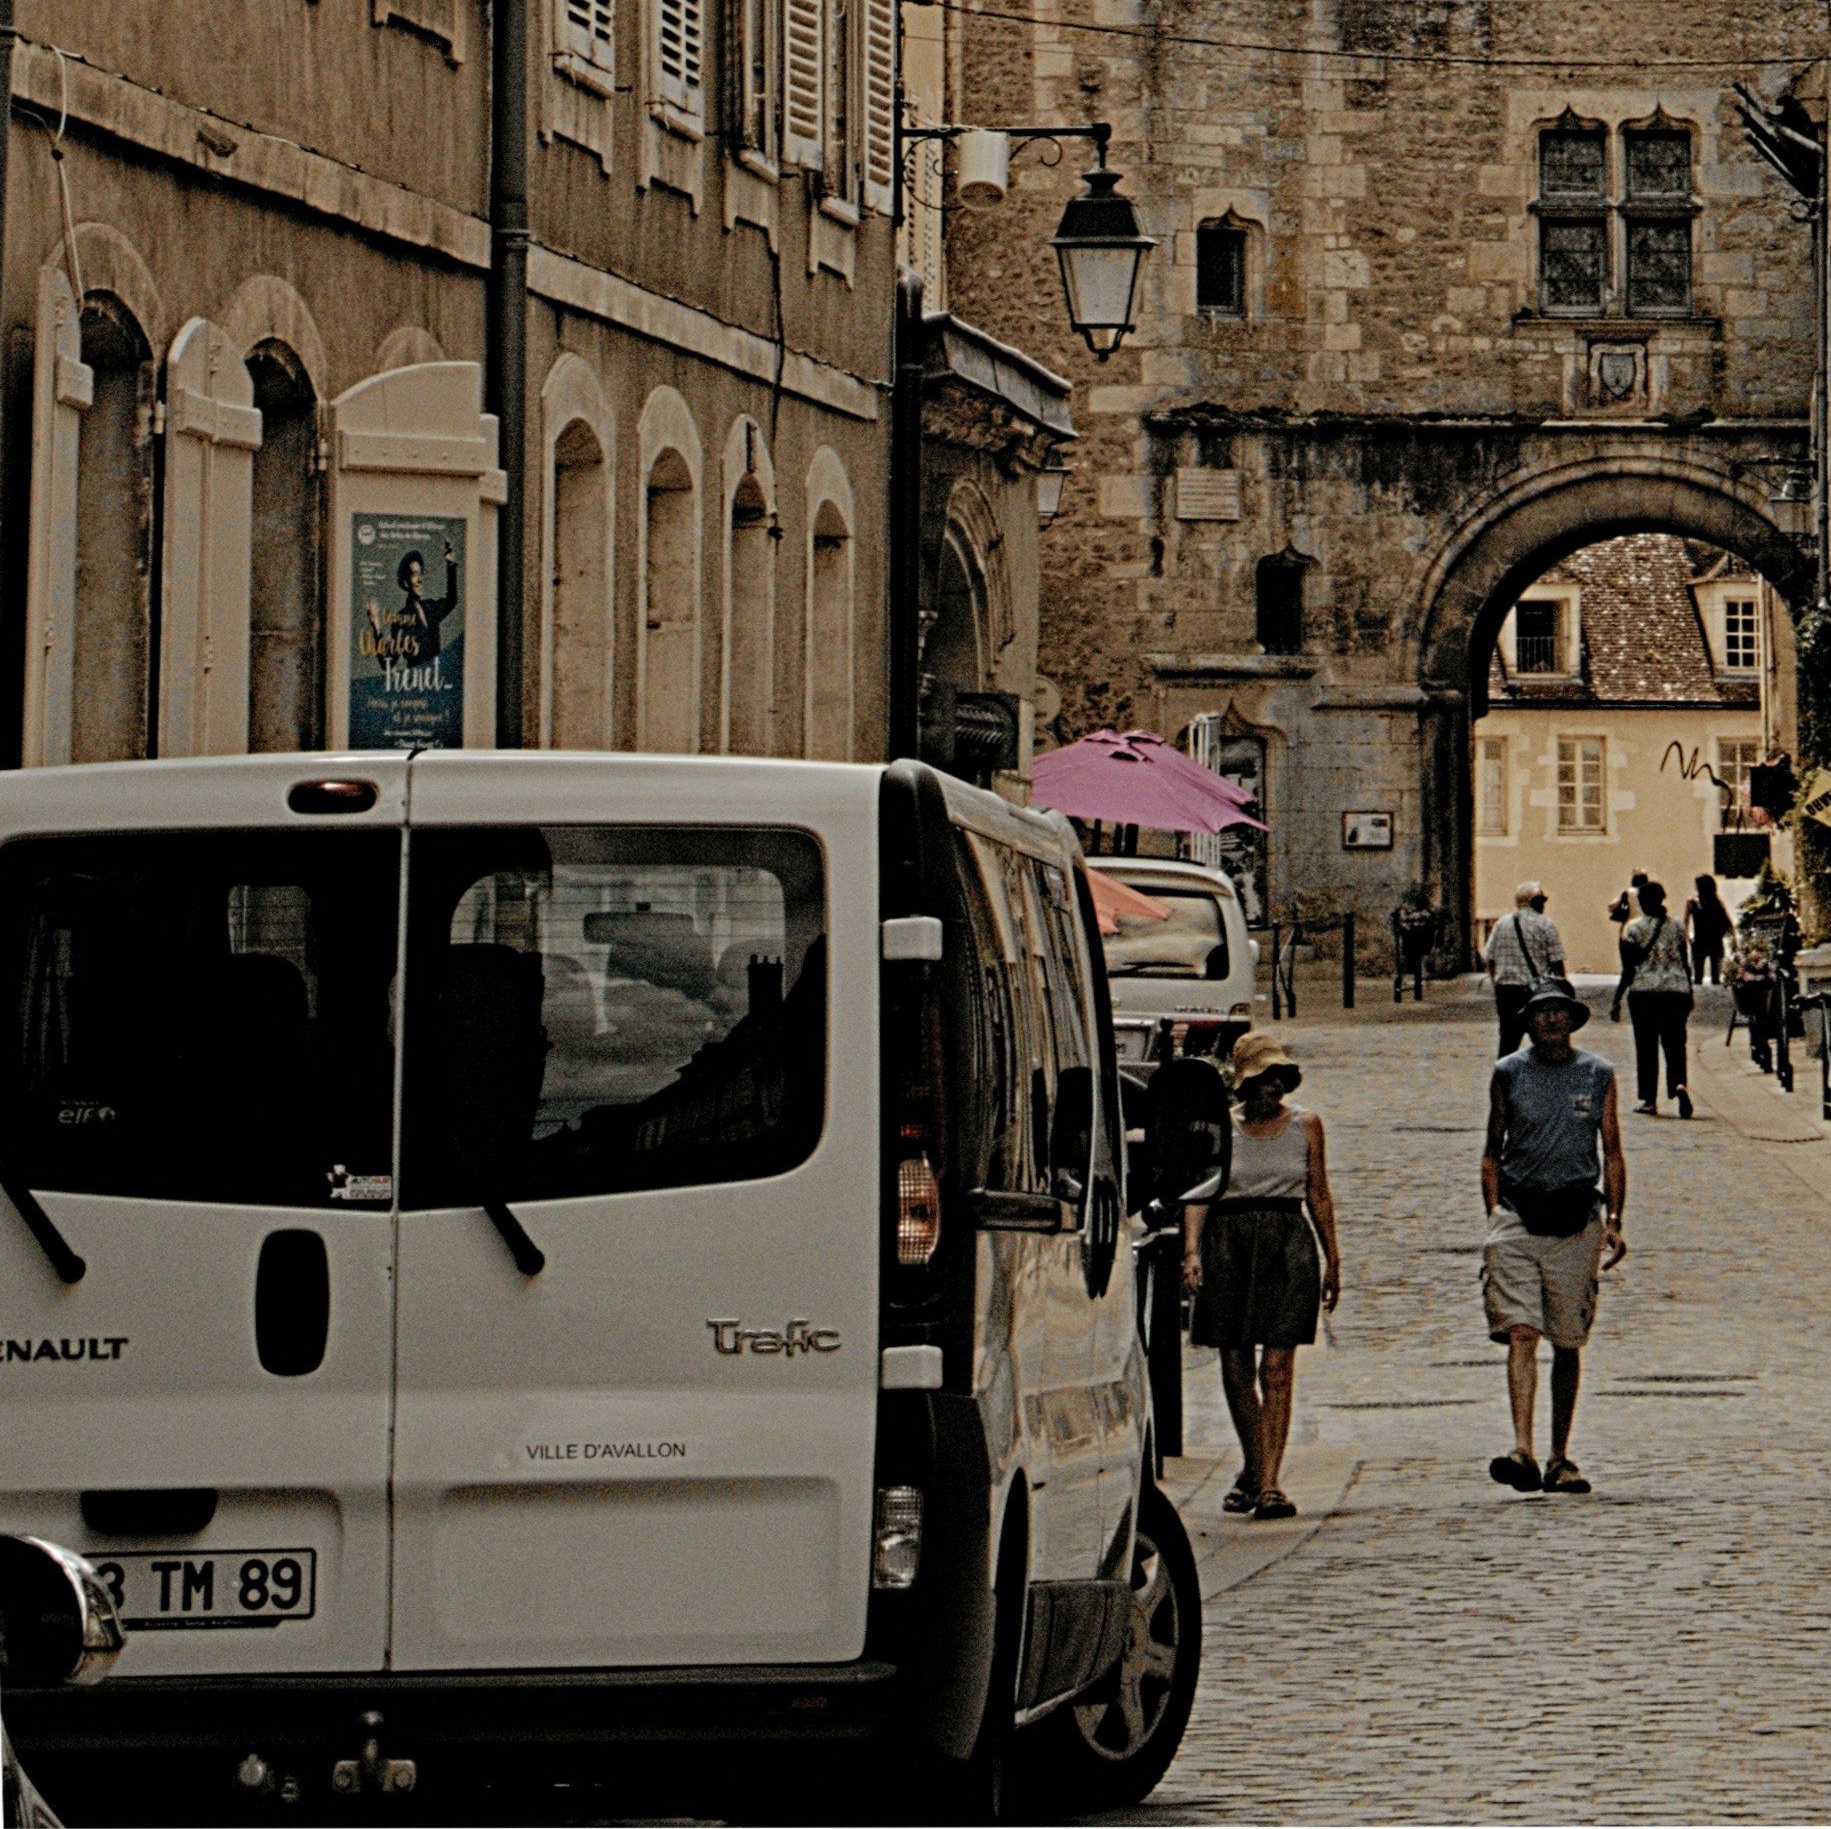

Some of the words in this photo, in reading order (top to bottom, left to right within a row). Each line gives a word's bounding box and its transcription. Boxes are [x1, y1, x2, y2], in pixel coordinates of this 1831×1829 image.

[0, 1338, 129, 1361] NAULT
[706, 1317, 841, 1357] Trafic
[526, 1444, 578, 1460] VILLE
[584, 1442, 686, 1459] D'AVALLON
[151, 1560, 214, 1612] TM
[238, 1558, 303, 1611] 89
